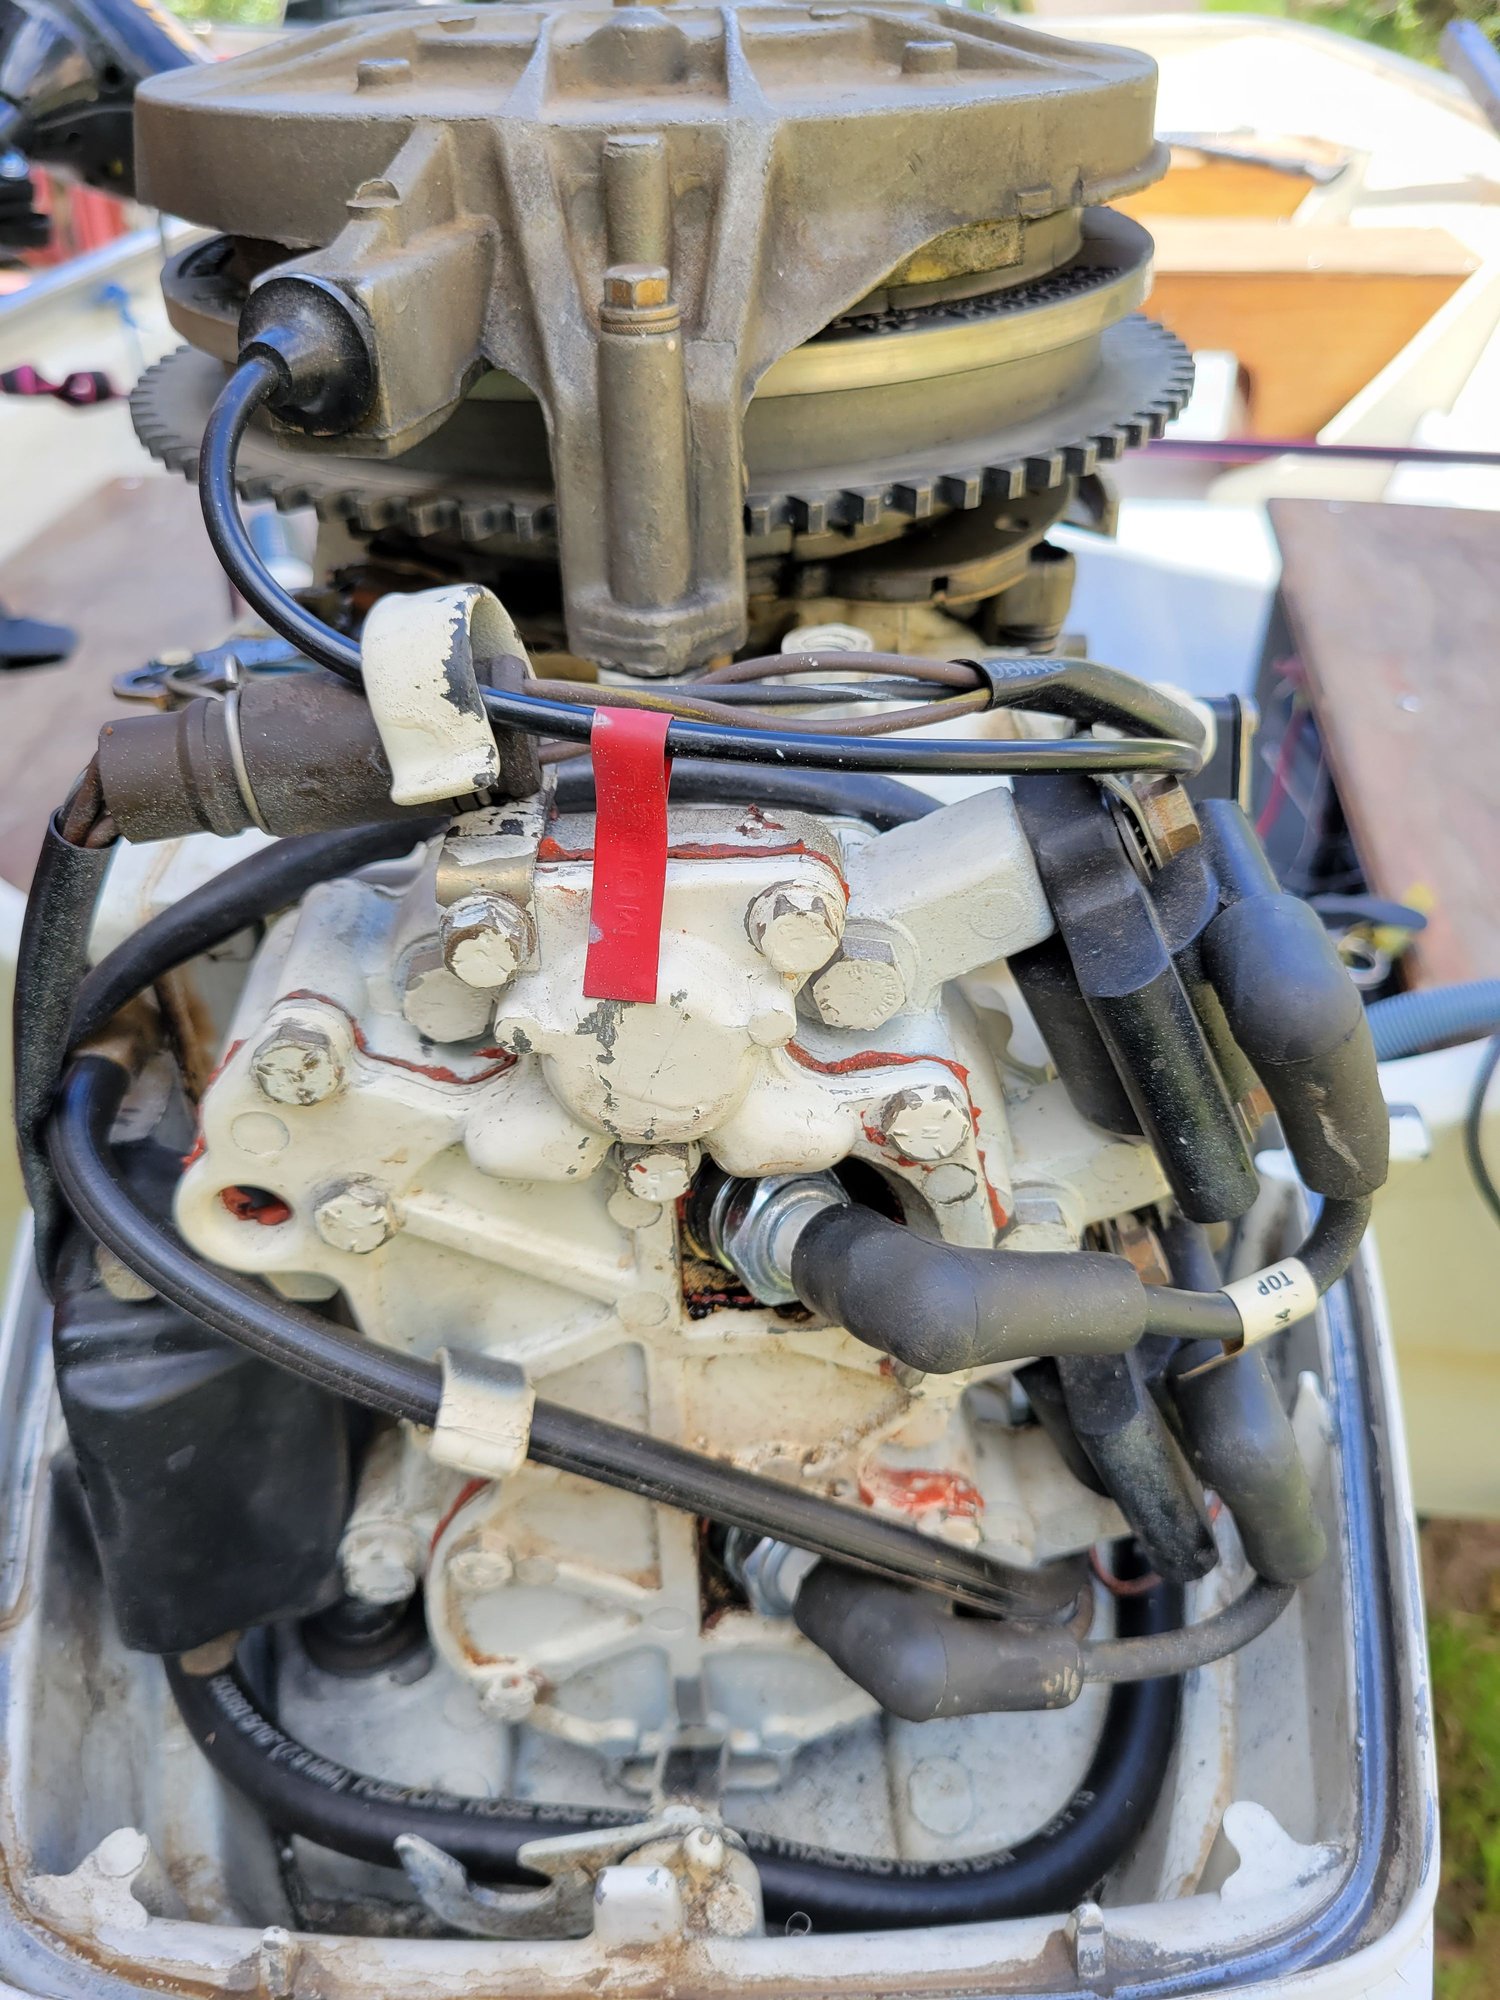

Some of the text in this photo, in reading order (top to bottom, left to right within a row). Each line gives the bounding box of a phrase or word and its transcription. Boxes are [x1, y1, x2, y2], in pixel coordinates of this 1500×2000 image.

[1257, 1270, 1294, 1296] TOP
[463, 1799, 534, 1819] HOSE
[536, 1802, 589, 1822] SAE
[777, 1837, 893, 1874] THAILAND
